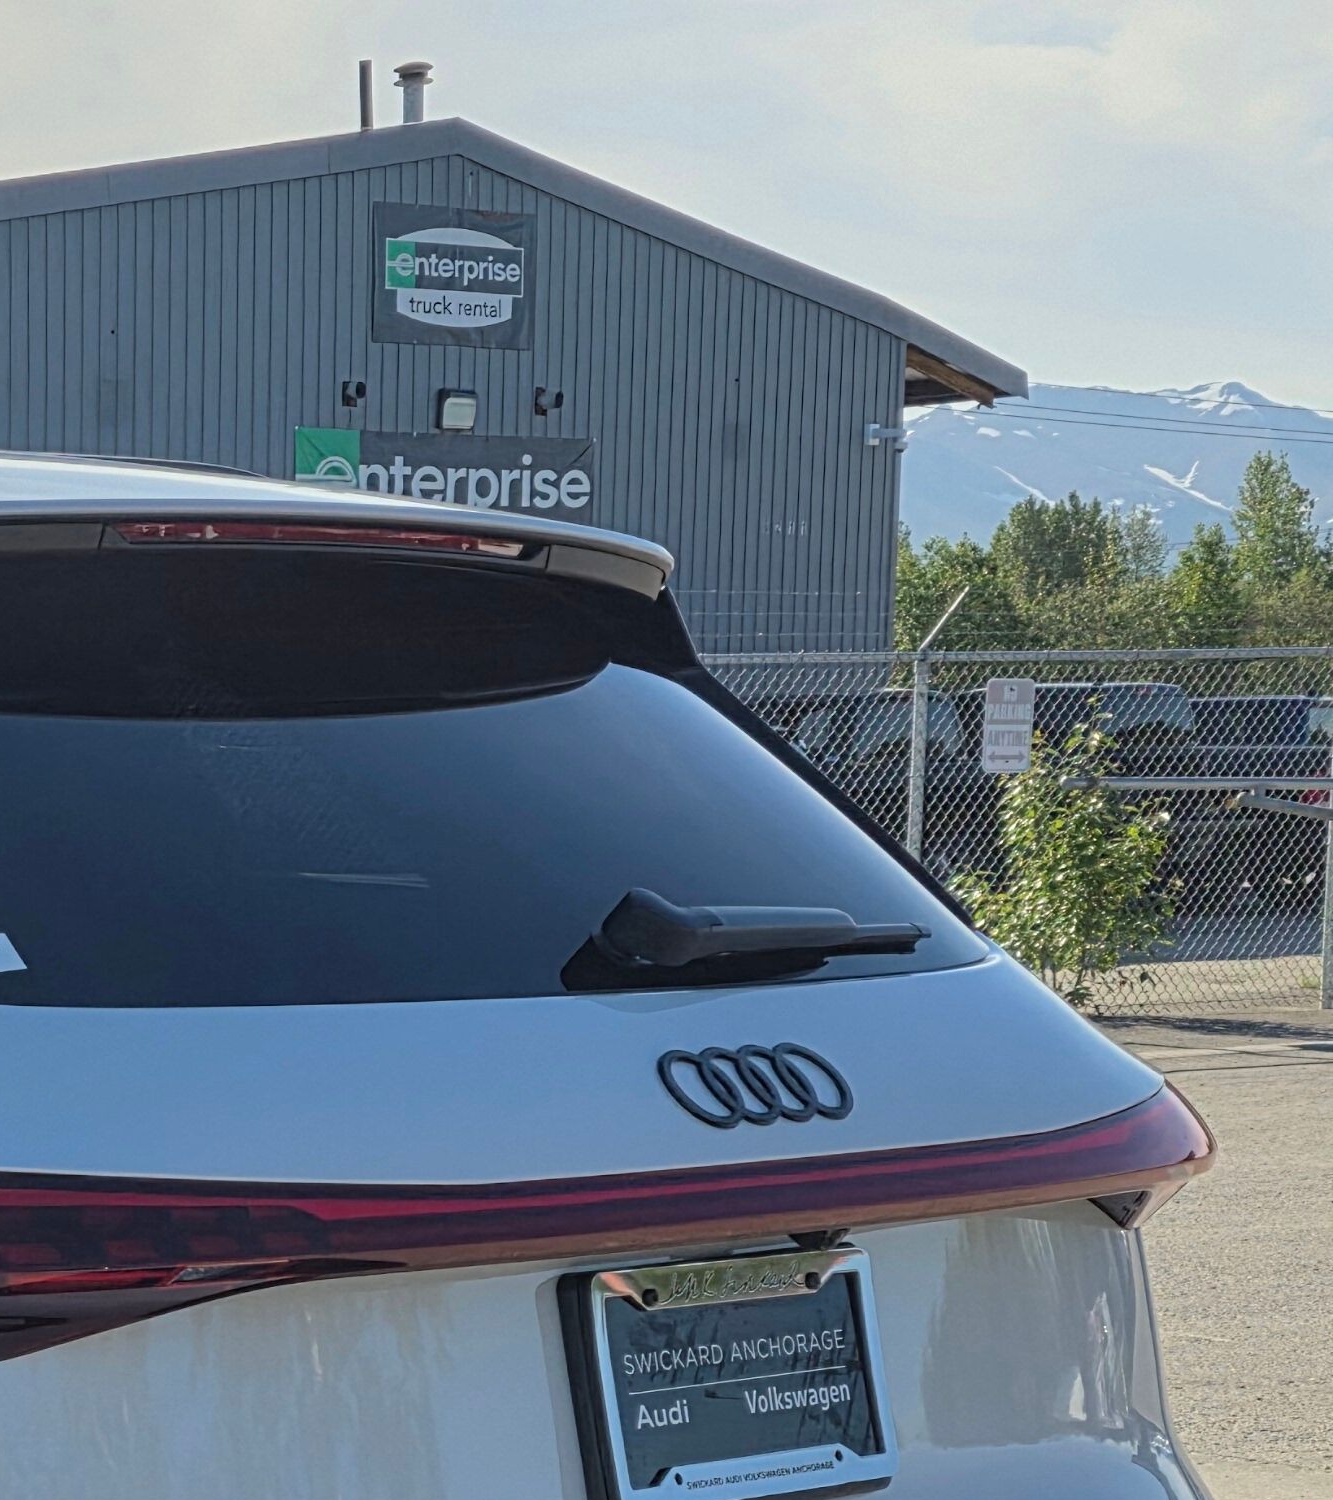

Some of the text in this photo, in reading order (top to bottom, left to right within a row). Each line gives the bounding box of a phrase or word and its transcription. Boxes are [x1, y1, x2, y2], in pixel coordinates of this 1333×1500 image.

[393, 250, 521, 287] enterprise
[409, 295, 502, 318] truck rental
[988, 703, 1032, 720] PARKING
[623, 1329, 846, 1375] SWICKARD ANCHORAGE
[636, 1383, 851, 1430] Audi Volkswagen
[686, 1476, 724, 1490] SWICKARD
[724, 1474, 743, 1485] AUDI
[743, 1467, 791, 1482] VOLKSWAGEN
